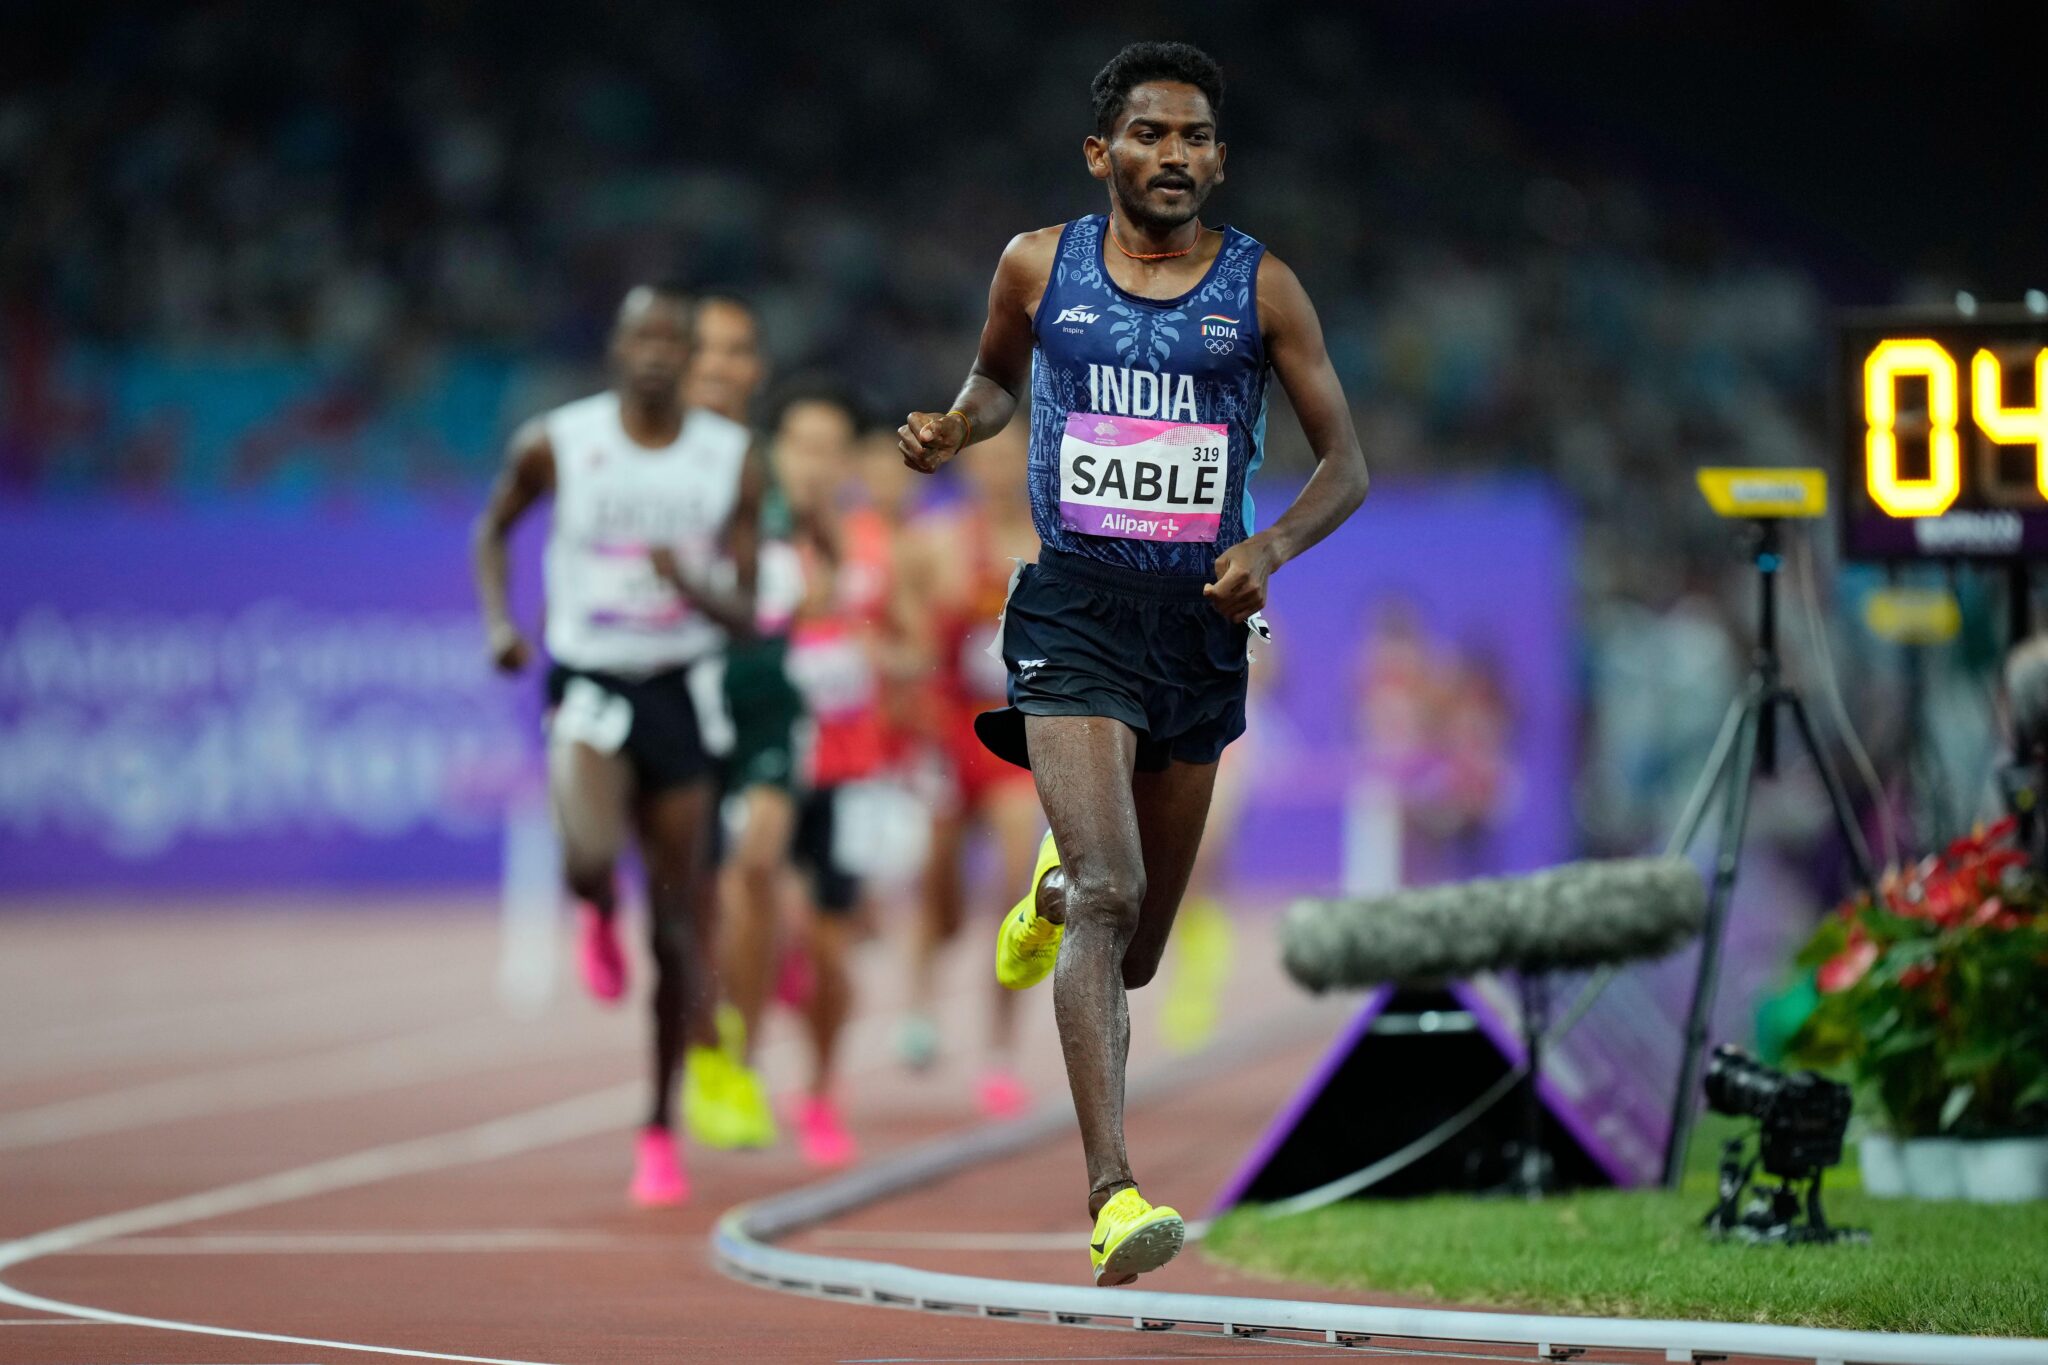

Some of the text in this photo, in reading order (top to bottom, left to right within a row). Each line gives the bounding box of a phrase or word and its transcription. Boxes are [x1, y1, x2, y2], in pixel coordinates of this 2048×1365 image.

[1052, 310, 1100, 324] JSW
[1062, 326, 1084, 335] Inspire
[1201, 324, 1238, 340] INDIA
[1089, 363, 1199, 422] INDIA
[1864, 338, 2048, 518] 04
[1192, 446, 1219, 462] 319
[1071, 454, 1218, 505] SABLE
